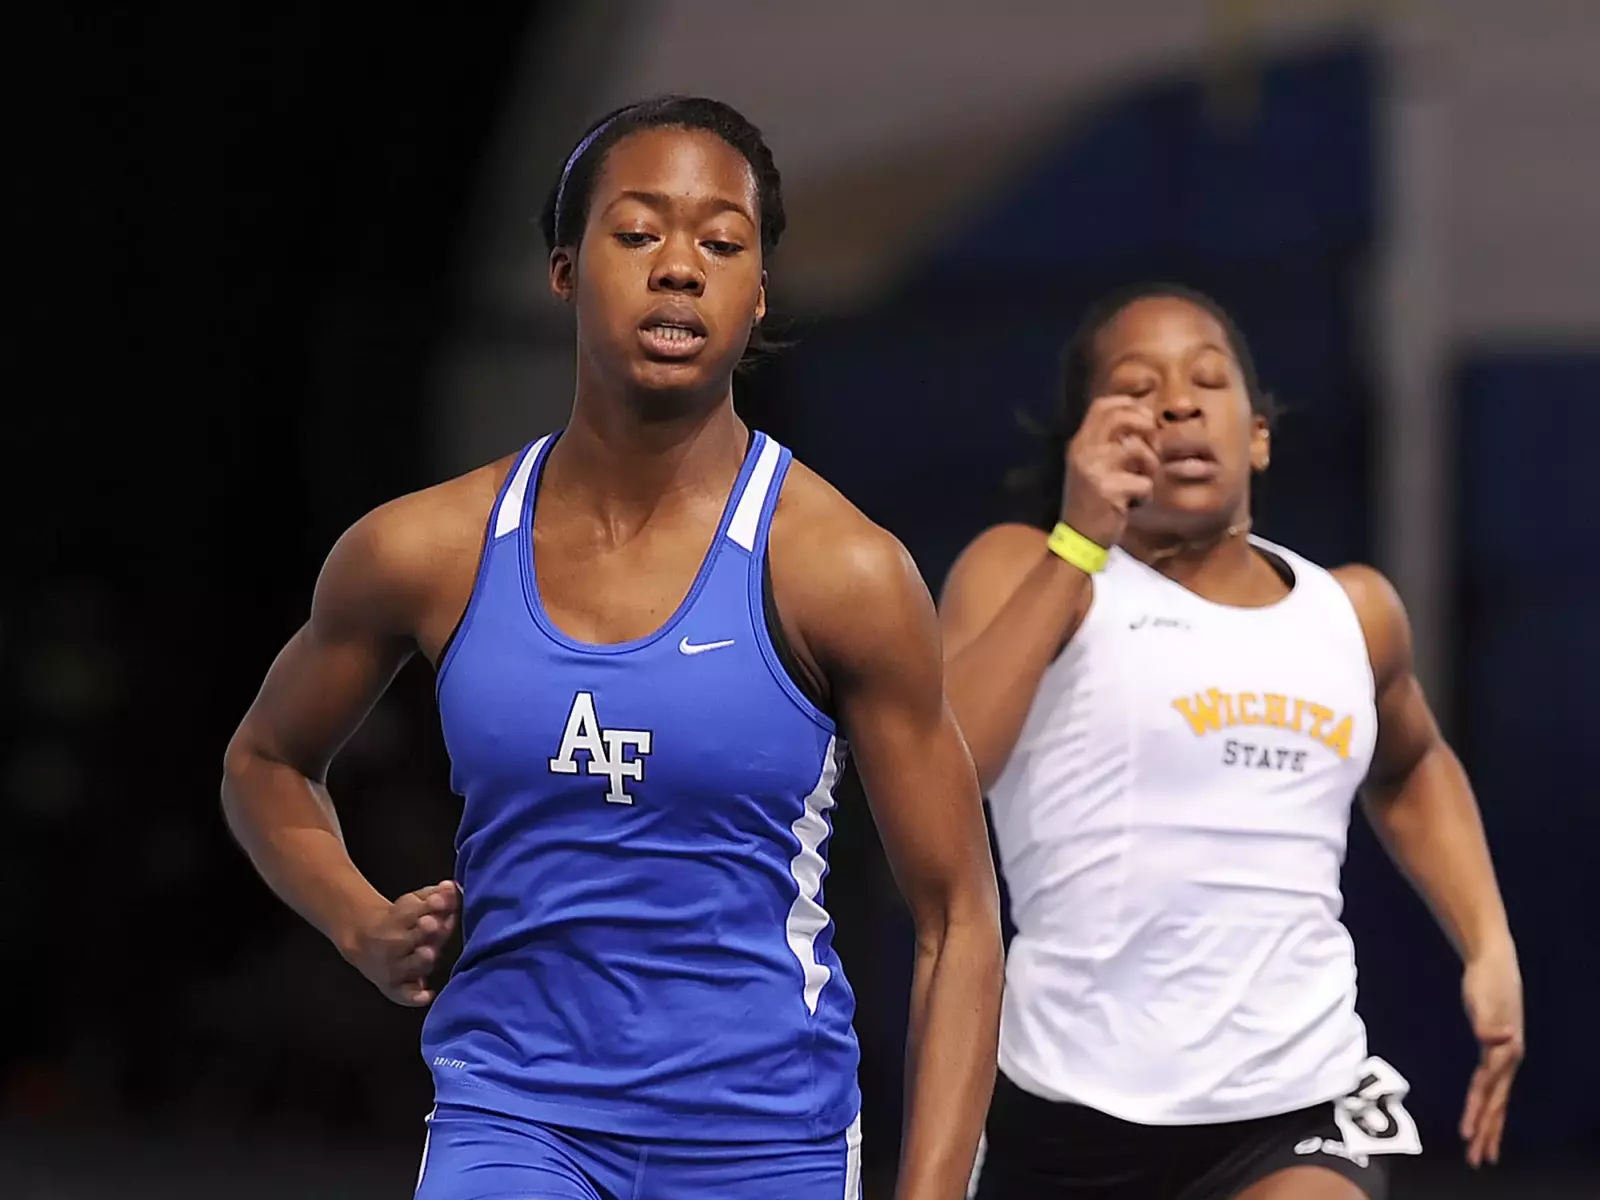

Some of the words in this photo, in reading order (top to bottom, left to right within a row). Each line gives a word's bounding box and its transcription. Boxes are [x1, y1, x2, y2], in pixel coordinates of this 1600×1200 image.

[548, 690, 652, 806] AF
[1171, 687, 1354, 760] WICHITA
[1222, 738, 1308, 773] STATE
